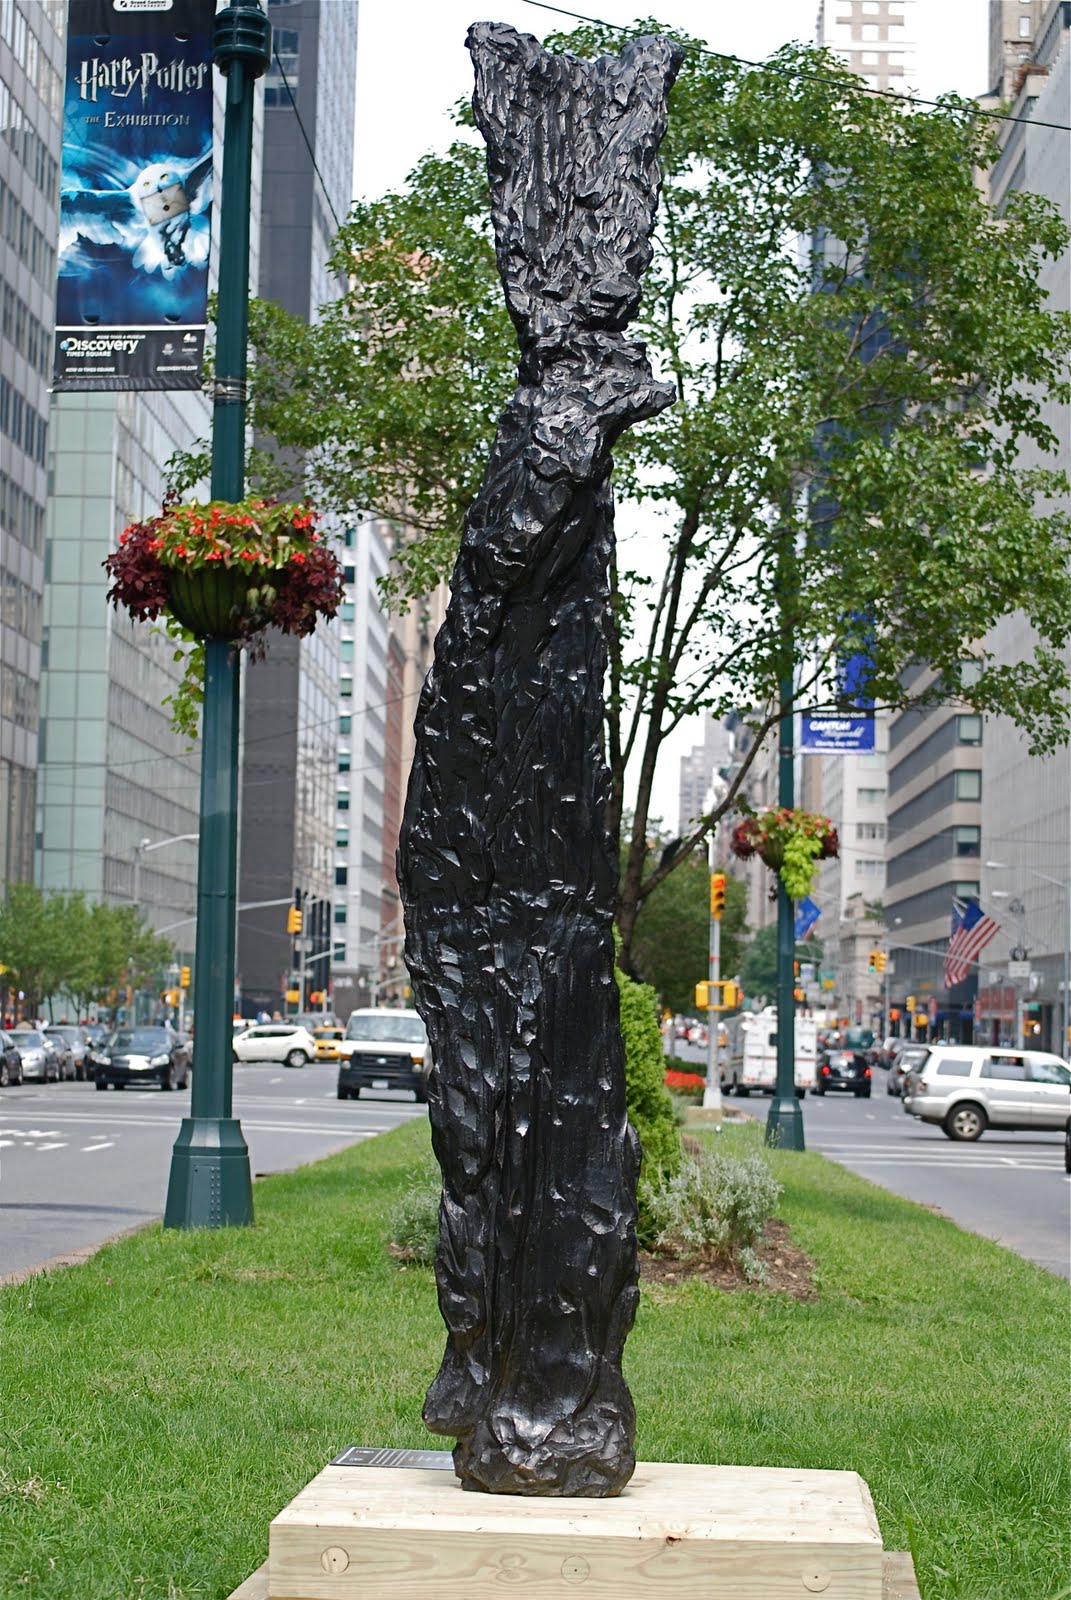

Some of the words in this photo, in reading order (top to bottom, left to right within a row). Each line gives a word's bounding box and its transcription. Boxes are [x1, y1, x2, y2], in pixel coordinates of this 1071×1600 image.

[74, 56, 139, 103] Harry
[139, 52, 208, 110] Potter
[84, 116, 101, 124] THE
[103, 111, 190, 128] EXHIBITION
